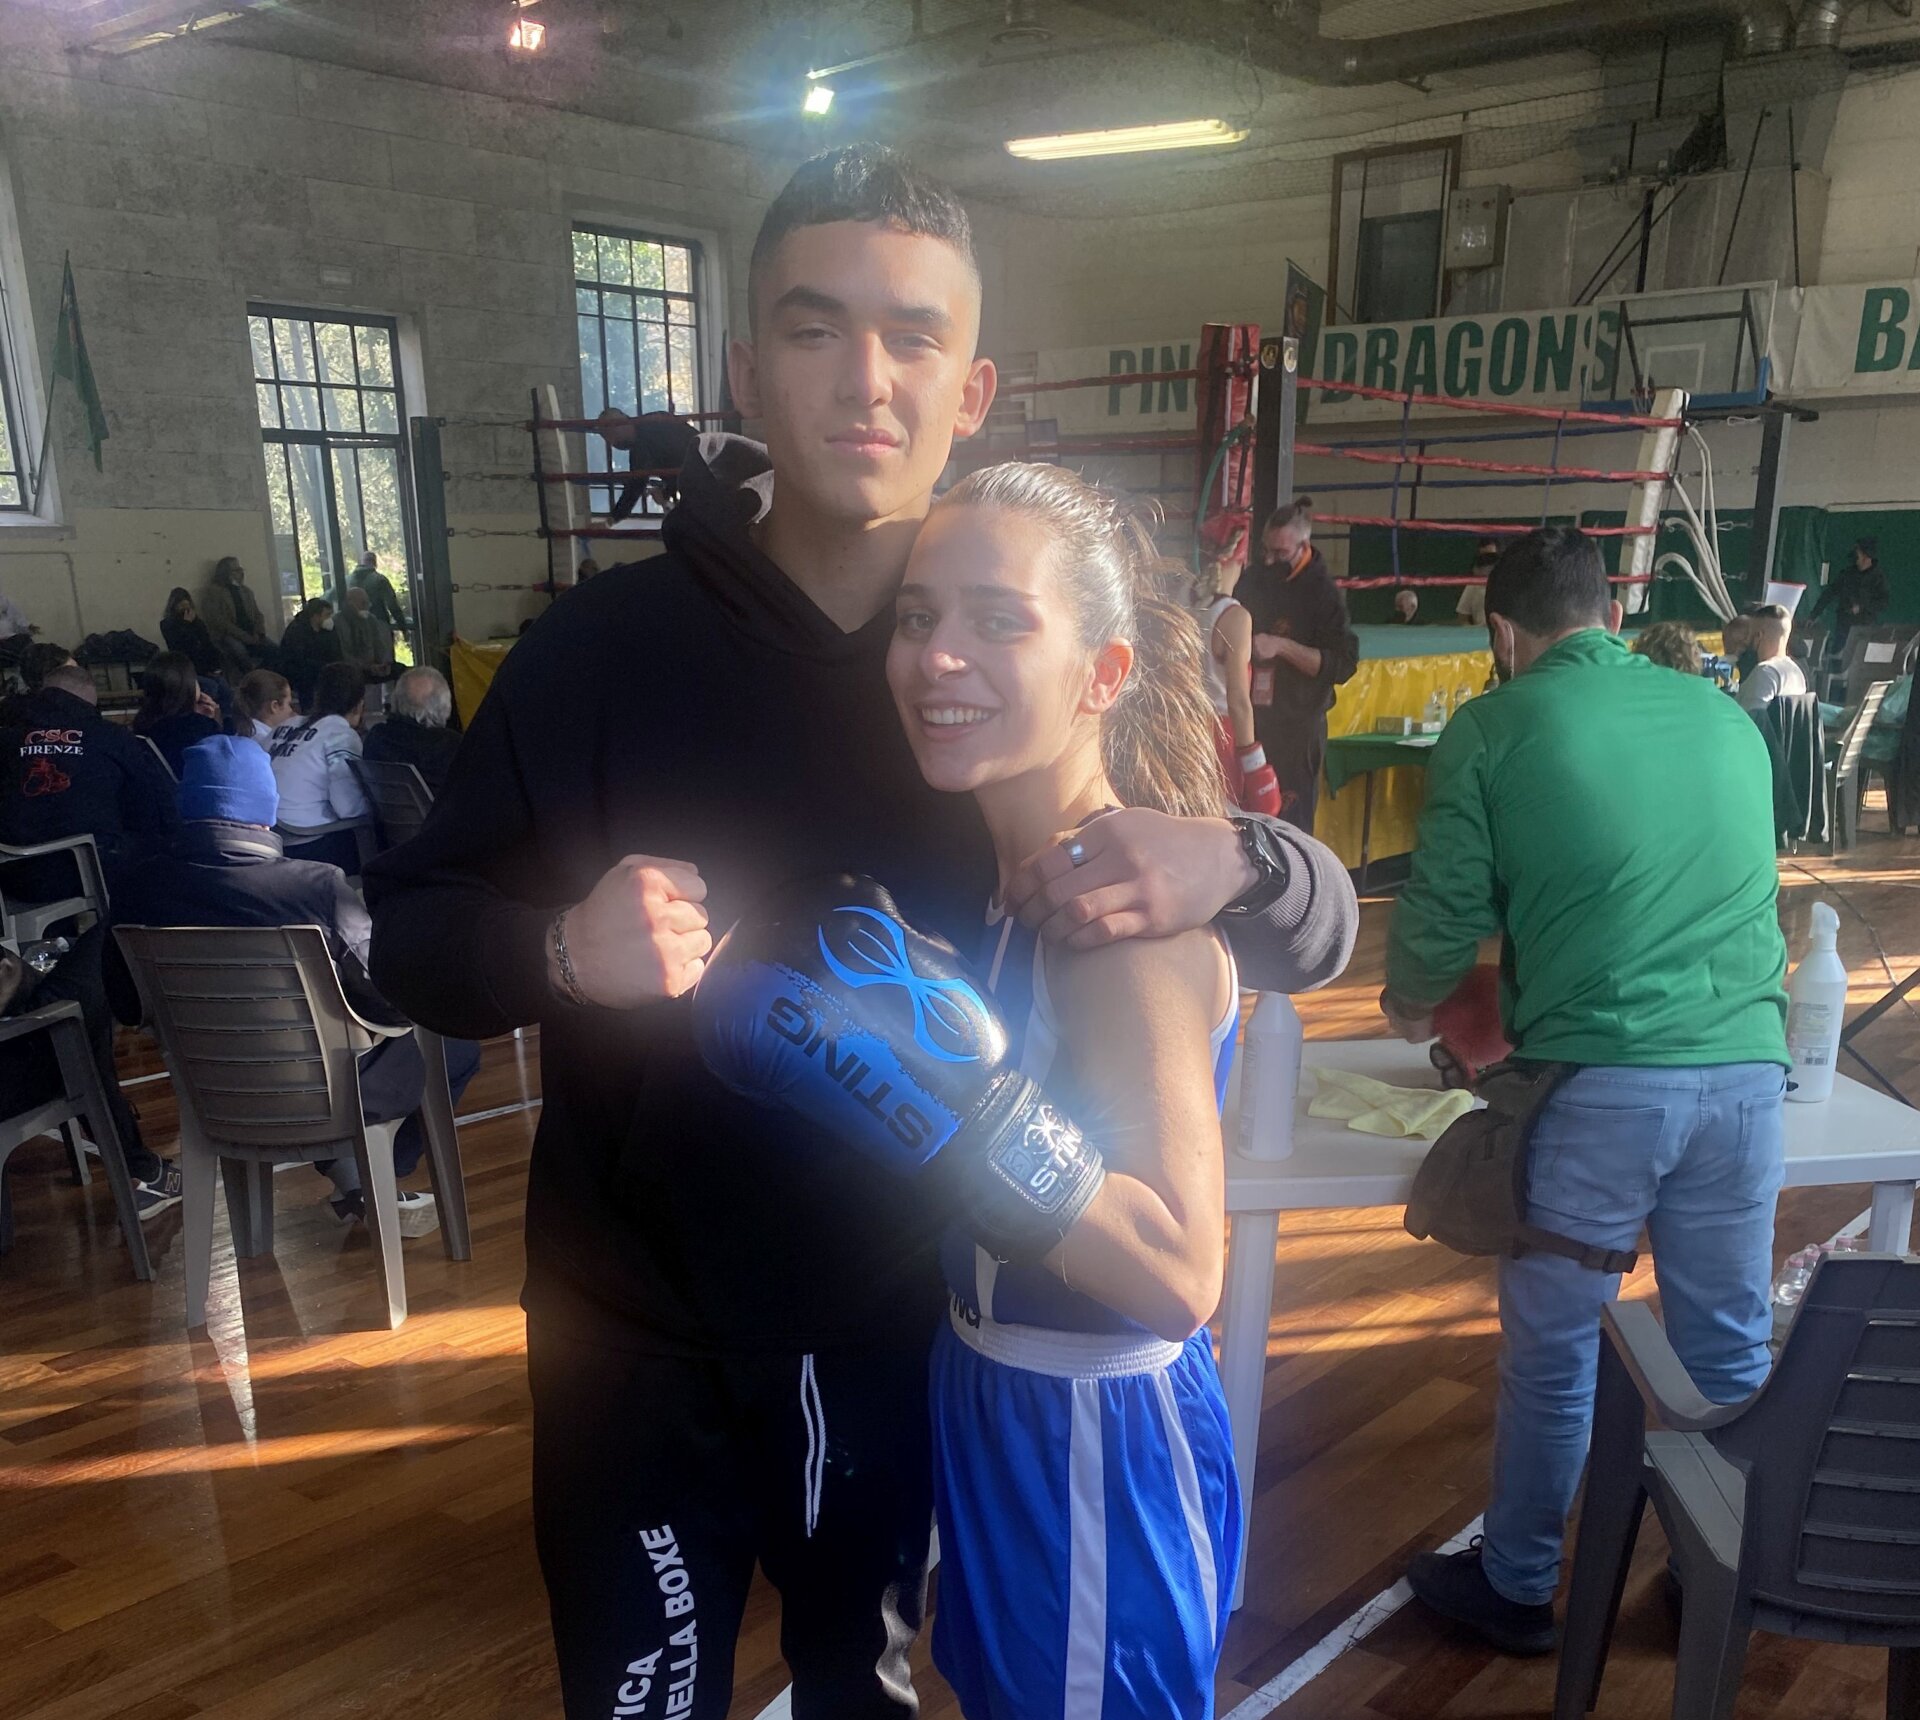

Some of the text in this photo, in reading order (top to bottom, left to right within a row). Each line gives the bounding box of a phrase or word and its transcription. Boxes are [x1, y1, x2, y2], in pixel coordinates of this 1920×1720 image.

[1107, 344, 1200, 416] PIN
[1319, 310, 1622, 404] DRAGONS
[20, 744, 84, 757] FIRENZE
[767, 997, 933, 1149] STING
[639, 1524, 695, 1619] BOXE
[612, 1648, 664, 1720] ICA
